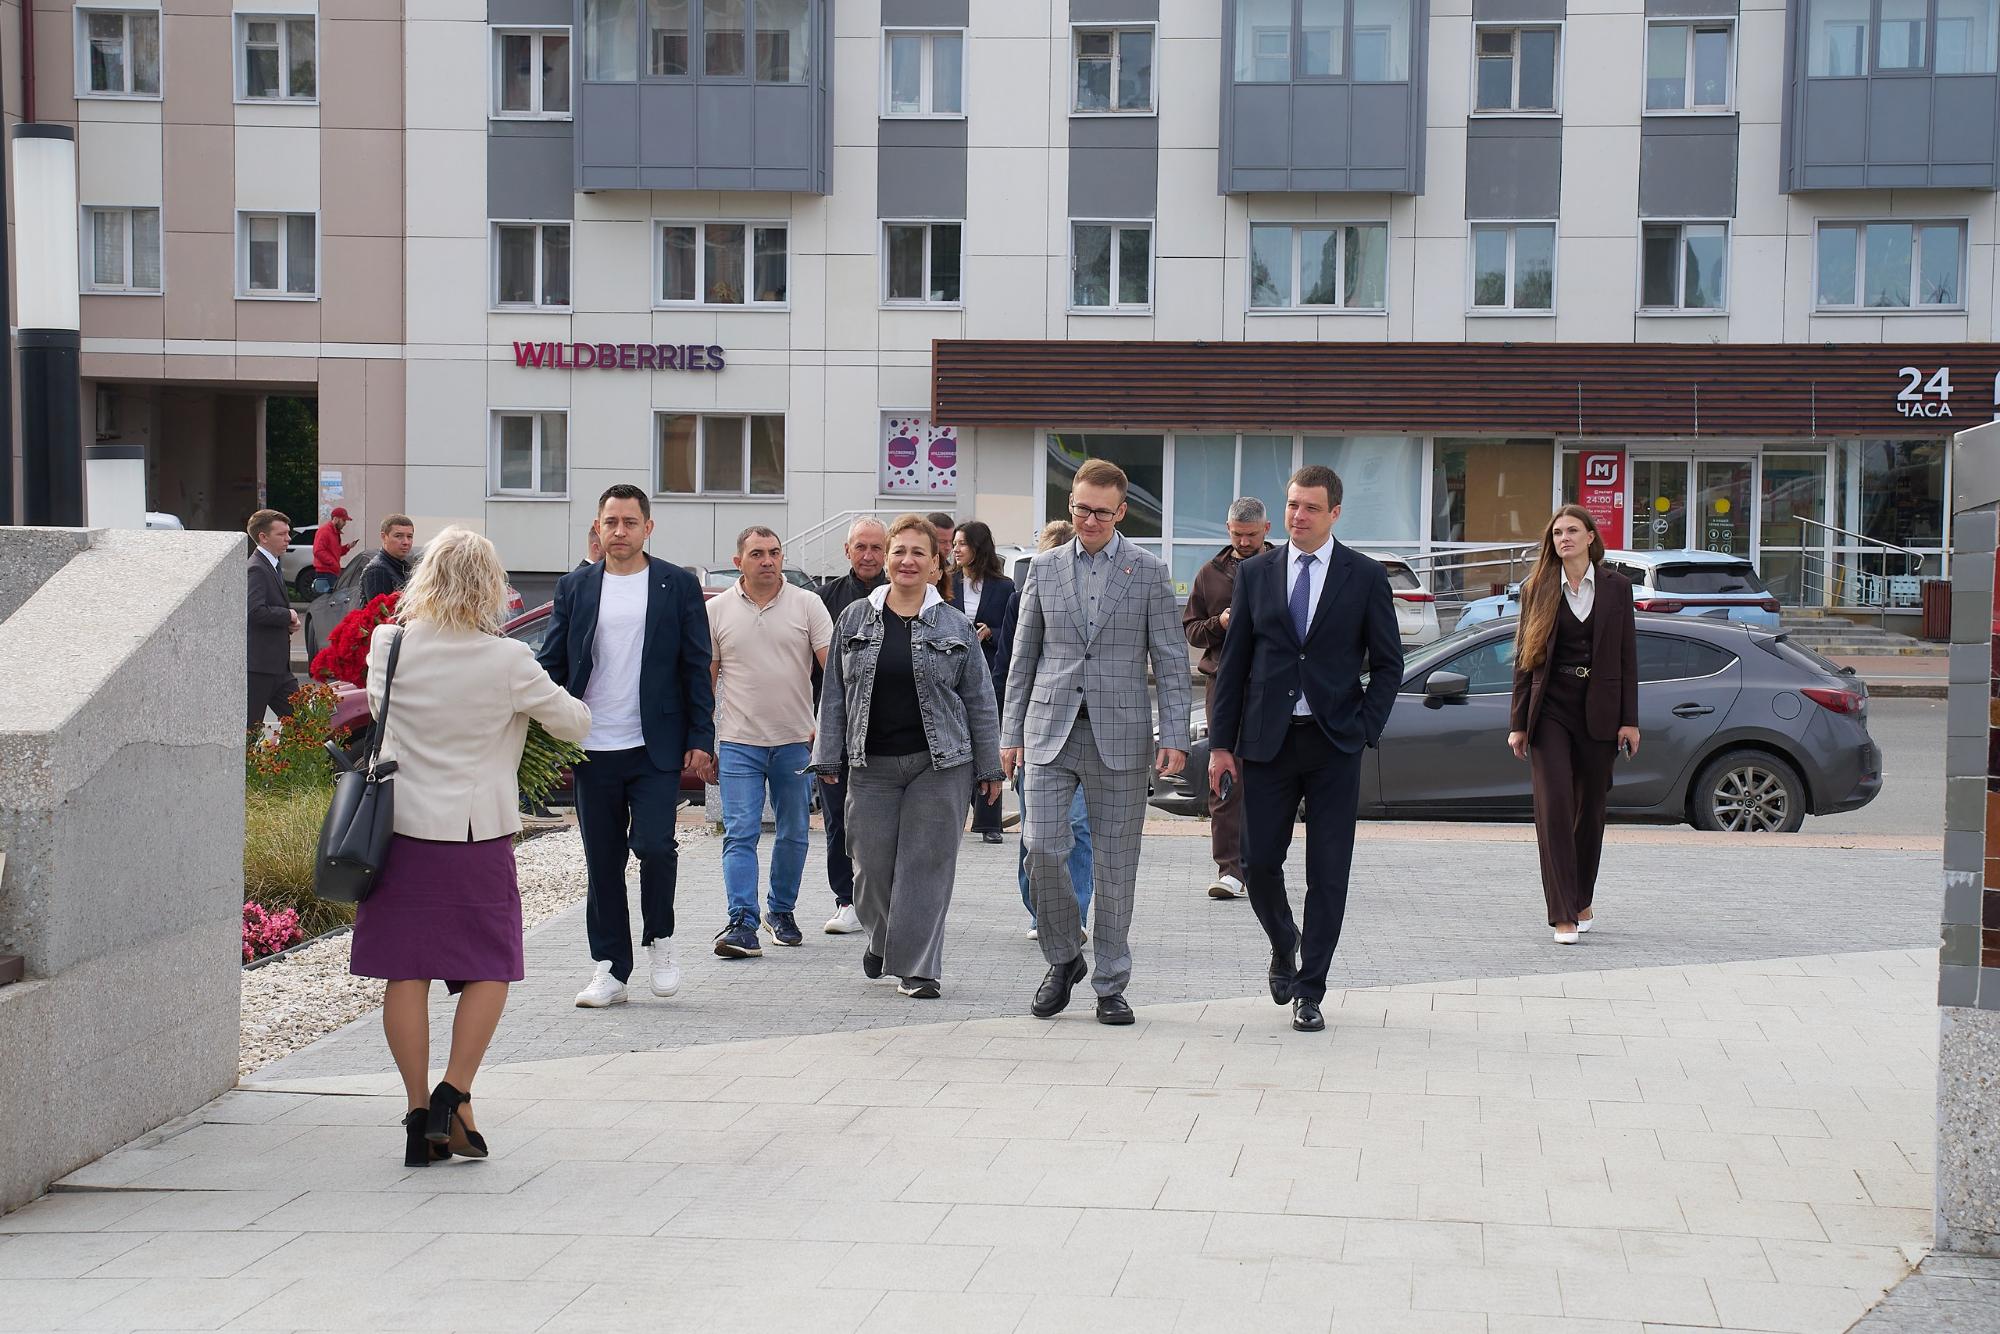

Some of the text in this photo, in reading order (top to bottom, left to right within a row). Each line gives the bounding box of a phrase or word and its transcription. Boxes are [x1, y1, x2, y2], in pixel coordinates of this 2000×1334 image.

[513, 341, 725, 371] WILDBERRIES
[1897, 366, 1954, 401] 24
[1896, 402, 1953, 417] ЧАСА
